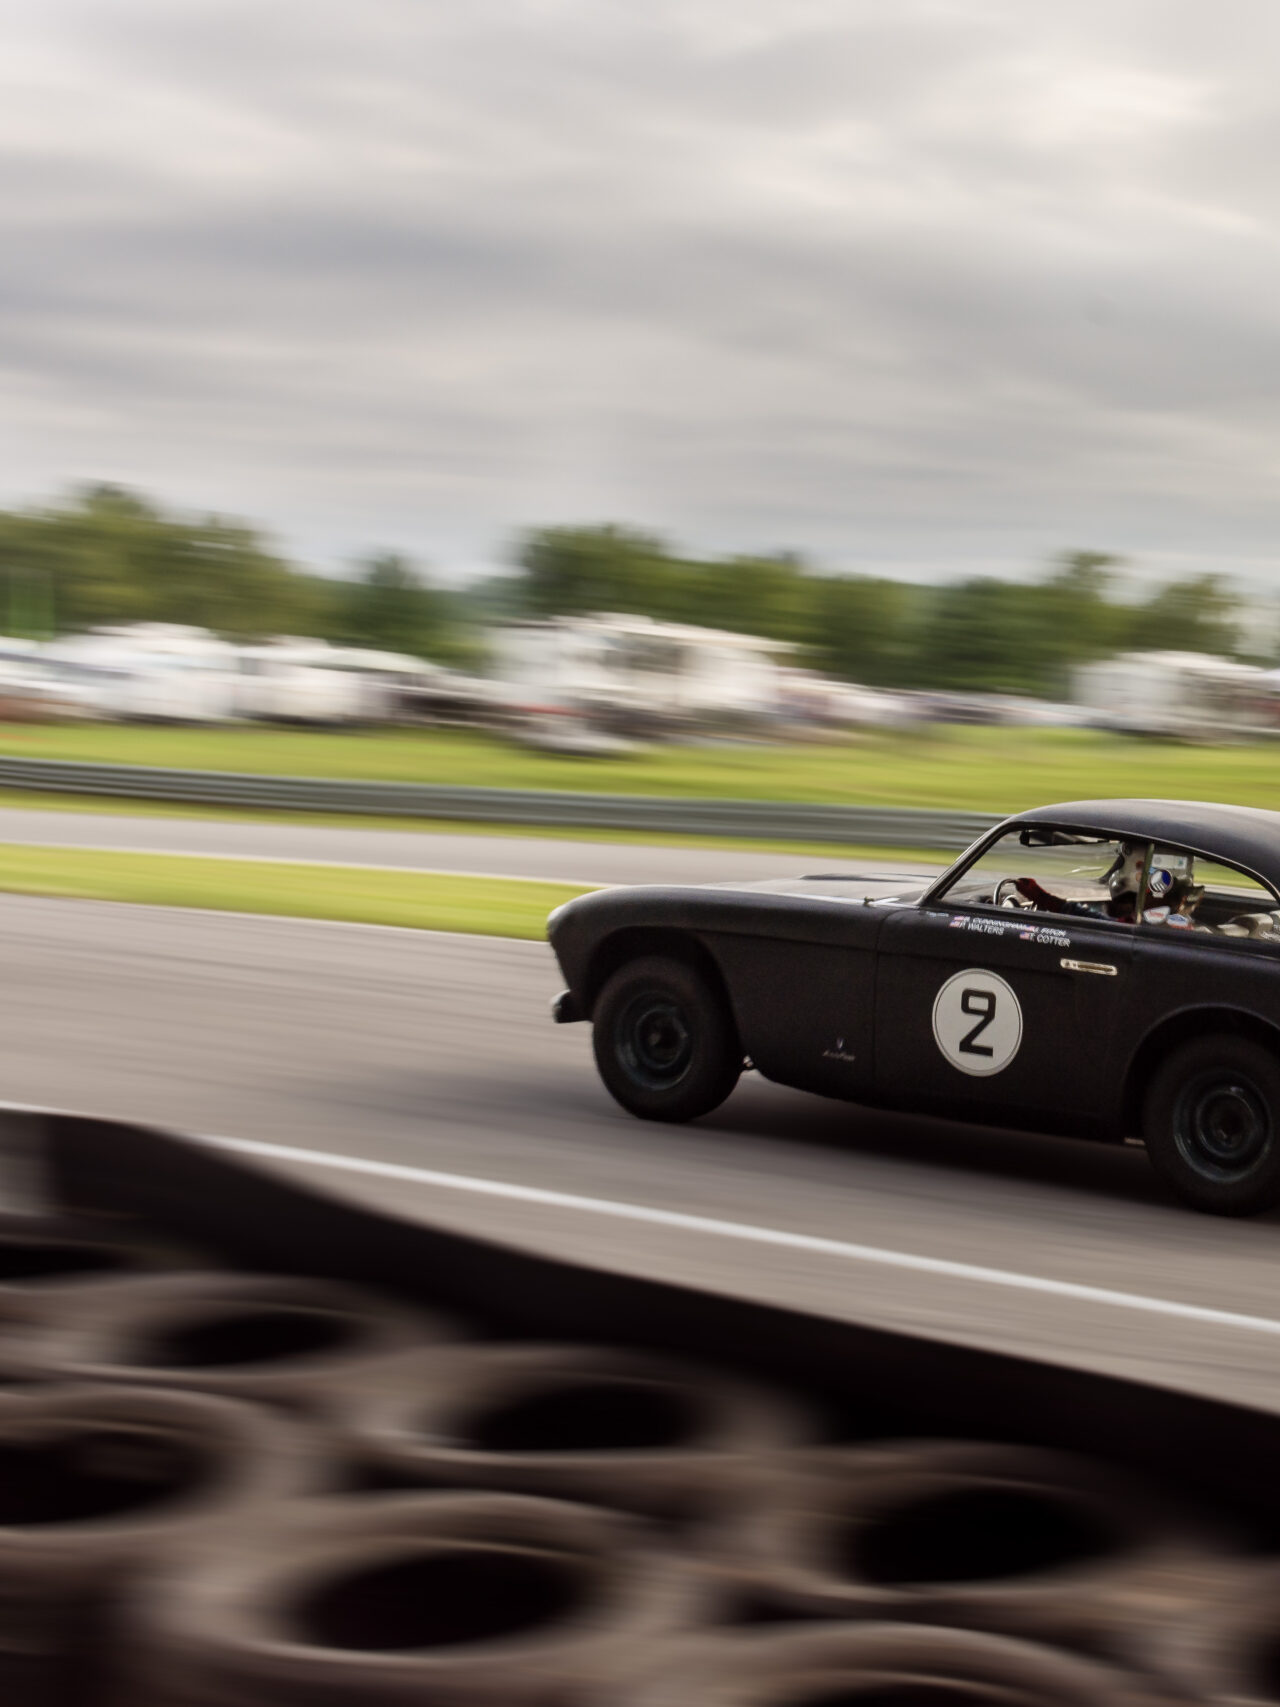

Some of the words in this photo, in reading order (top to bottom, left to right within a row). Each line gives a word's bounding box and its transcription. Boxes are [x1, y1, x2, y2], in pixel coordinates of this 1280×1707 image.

[967, 921, 1005, 936] WALTERS
[1036, 934, 1071, 948] COTTER
[959, 989, 997, 1057] 2
